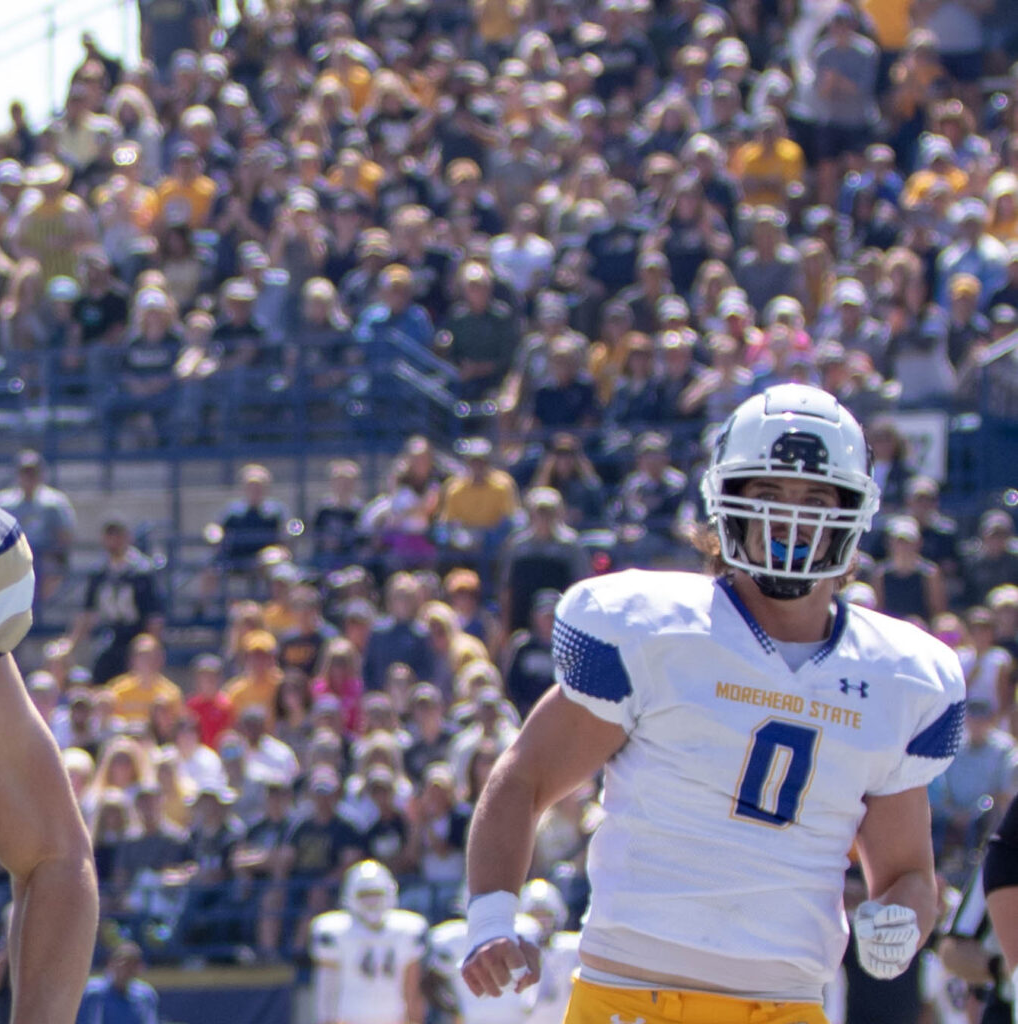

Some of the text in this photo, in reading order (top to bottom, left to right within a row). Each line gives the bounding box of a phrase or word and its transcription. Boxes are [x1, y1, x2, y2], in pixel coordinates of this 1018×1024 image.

[715, 681, 863, 729] MOREHEAD STATE
[728, 714, 824, 831] 0
